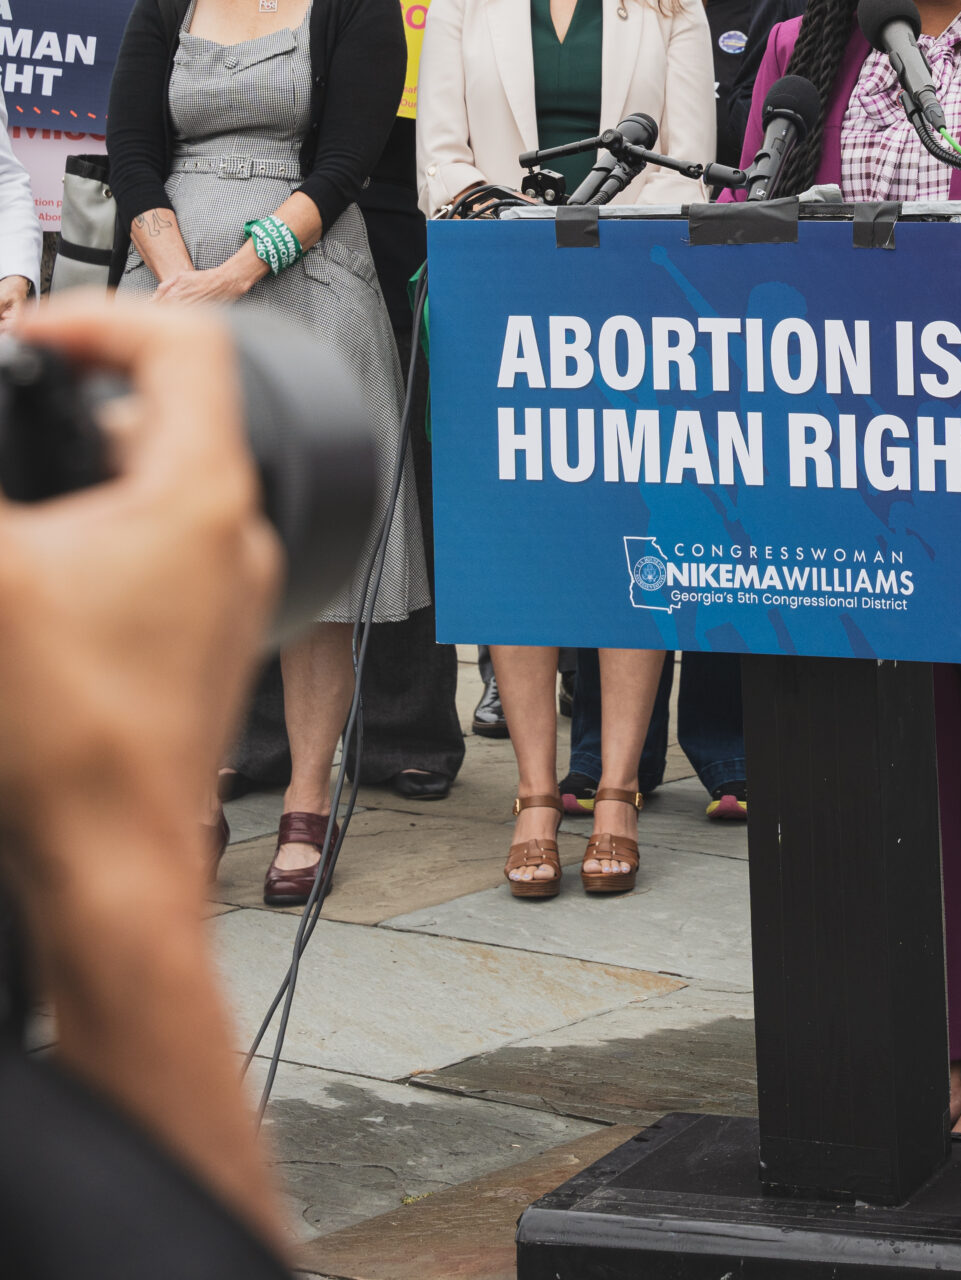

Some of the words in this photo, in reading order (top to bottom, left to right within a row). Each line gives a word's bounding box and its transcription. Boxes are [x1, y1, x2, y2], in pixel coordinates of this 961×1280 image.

[497, 315, 871, 395] ABORTION
[498, 407, 764, 486] HUMAN
[674, 543, 903, 564] CONGRESSWOMAN
[671, 590, 733, 605] Georgia's
[737, 592, 758, 604] 5th
[762, 593, 857, 609] Congressional
[863, 596, 908, 610] District
